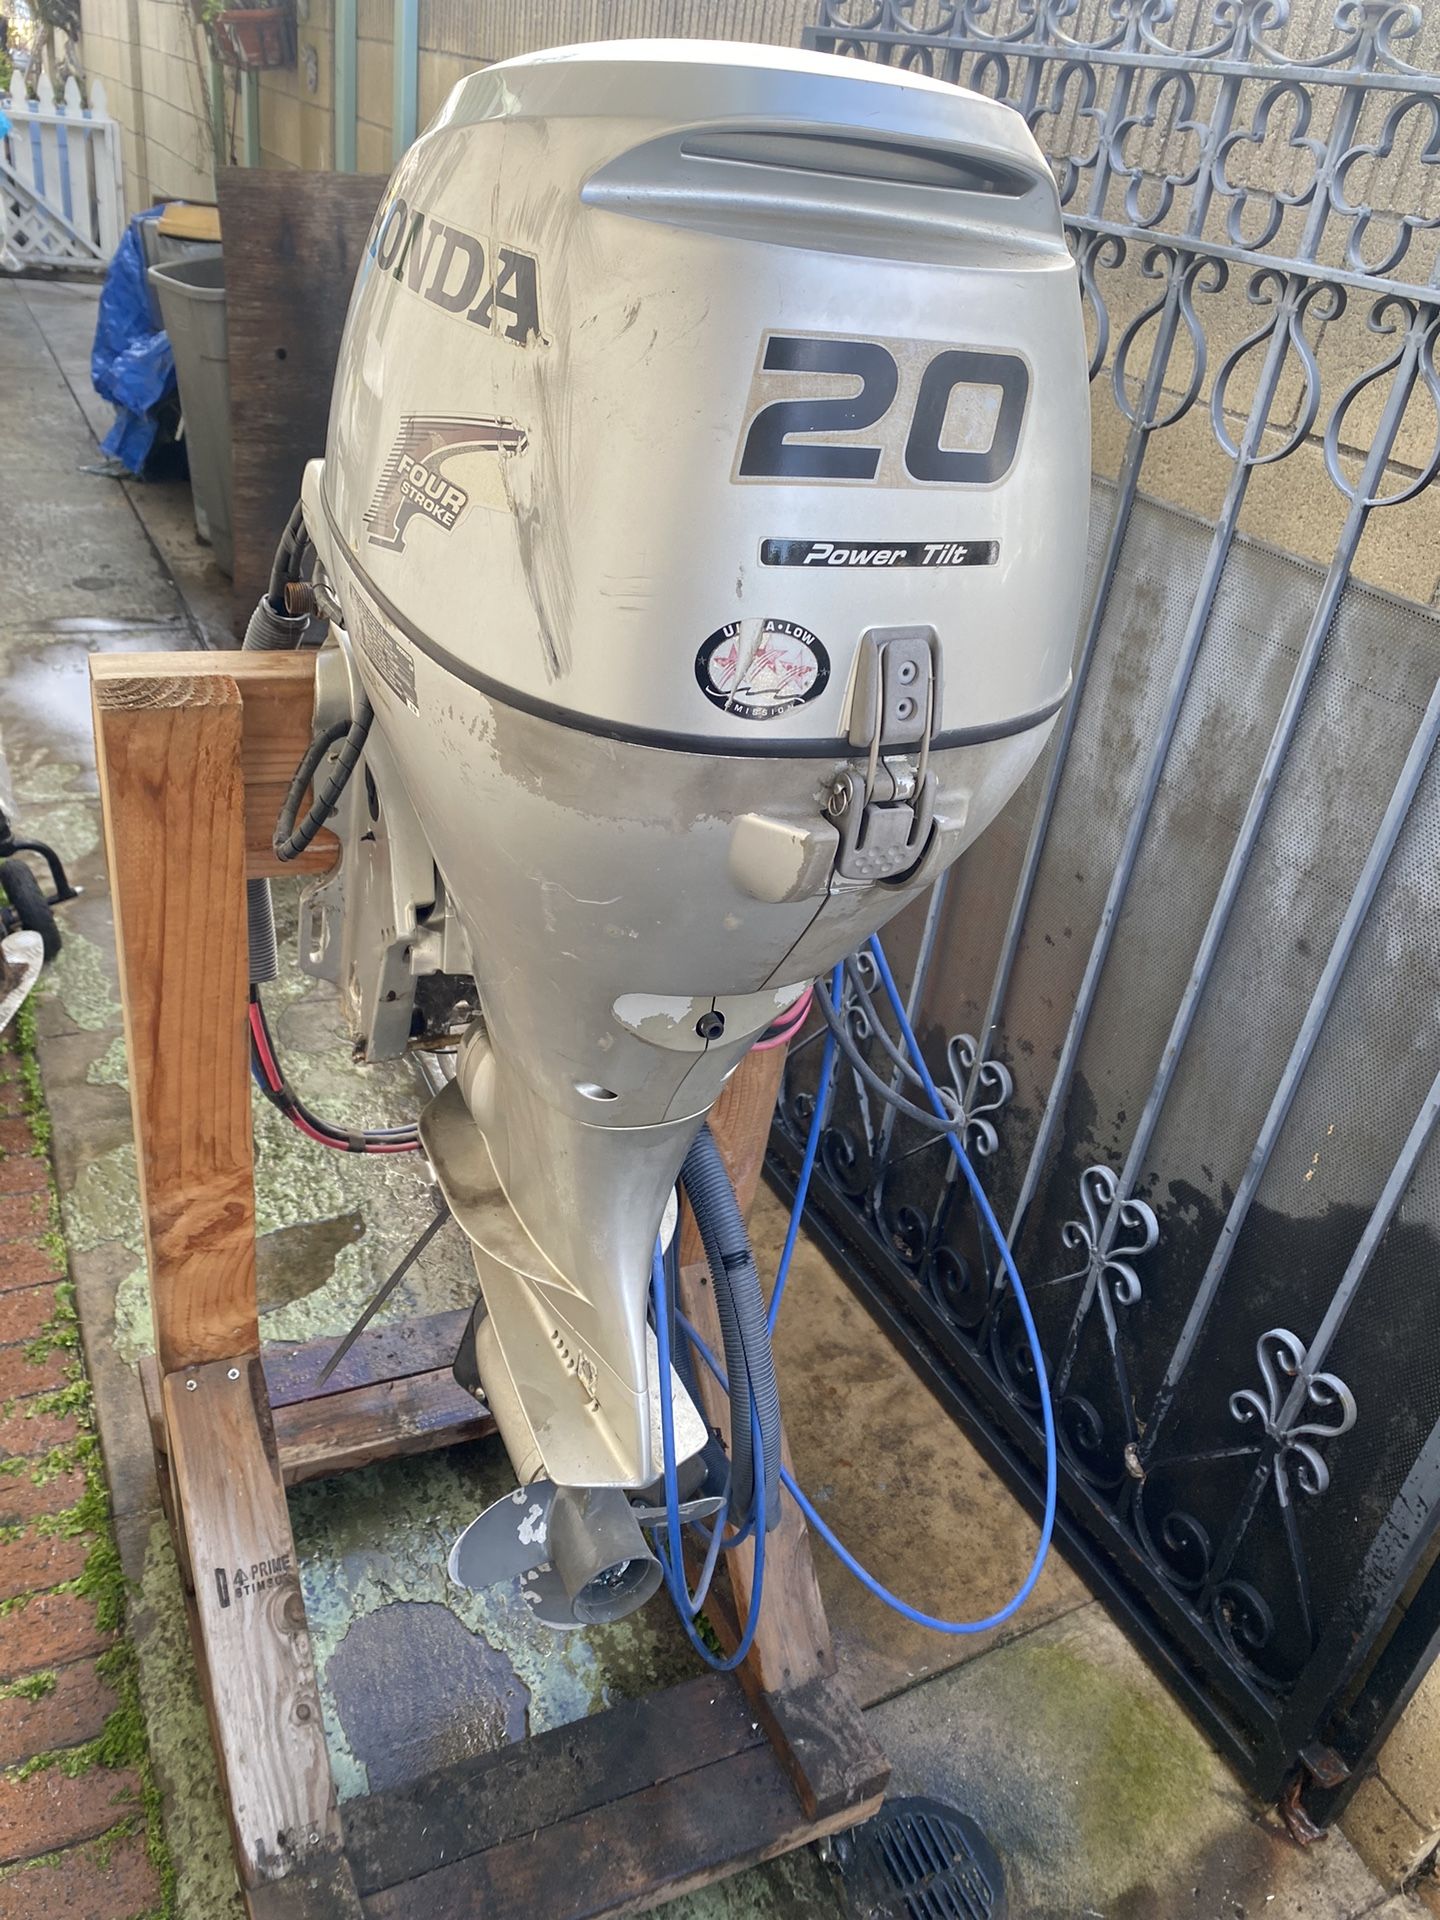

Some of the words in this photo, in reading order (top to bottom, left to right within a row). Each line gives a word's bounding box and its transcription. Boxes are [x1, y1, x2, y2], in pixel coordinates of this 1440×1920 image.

[369, 198, 550, 345] ONDA
[739, 336, 1029, 484] 20
[397, 454, 467, 514] FOUR
[401, 481, 455, 526] STROKE
[803, 543, 907, 566] Power
[922, 543, 968, 565] Tilt
[250, 1554, 291, 1580] PRIME
